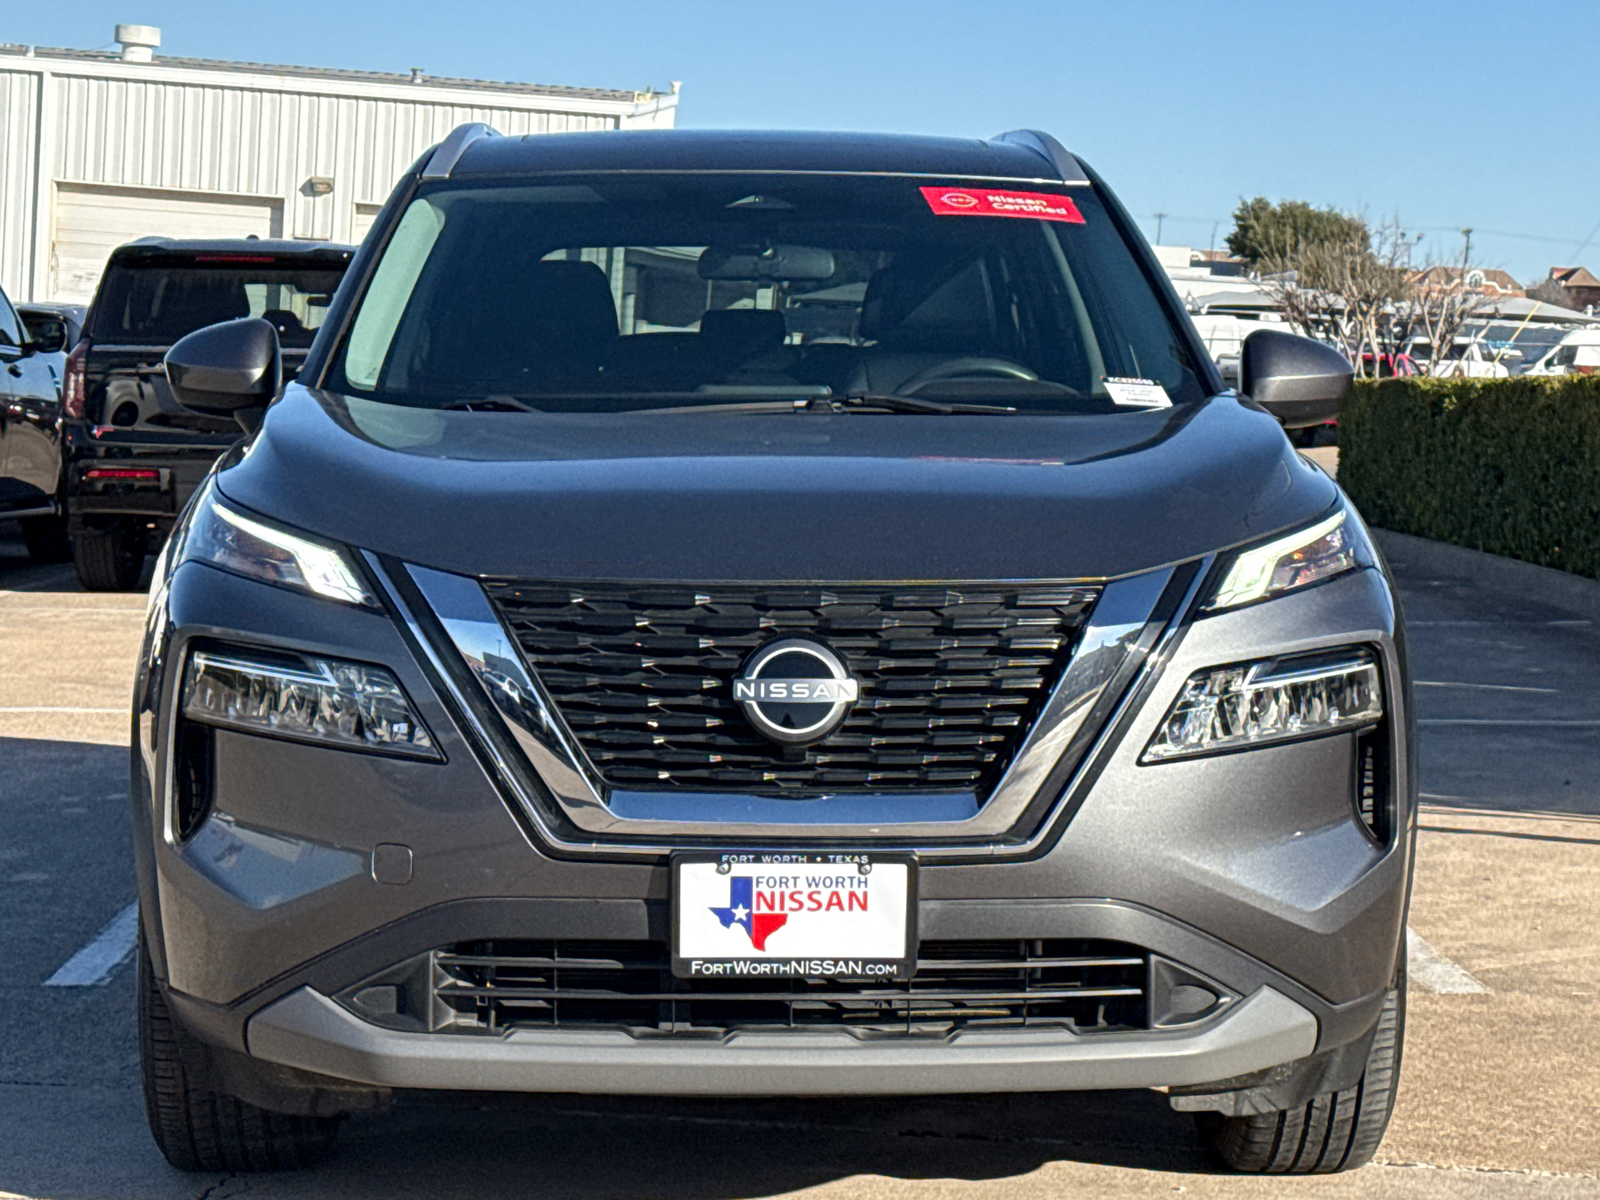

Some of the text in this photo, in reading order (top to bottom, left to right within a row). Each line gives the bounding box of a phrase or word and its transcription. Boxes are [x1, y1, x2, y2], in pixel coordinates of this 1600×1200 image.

[987, 195, 1047, 206] Nissan
[992, 202, 1068, 215] Certified
[736, 682, 854, 699] NISSAN
[721, 855, 869, 864] FORT WORTH TEXAS
[755, 876, 869, 889] FORT WORTH
[755, 890, 869, 912] NISSAN
